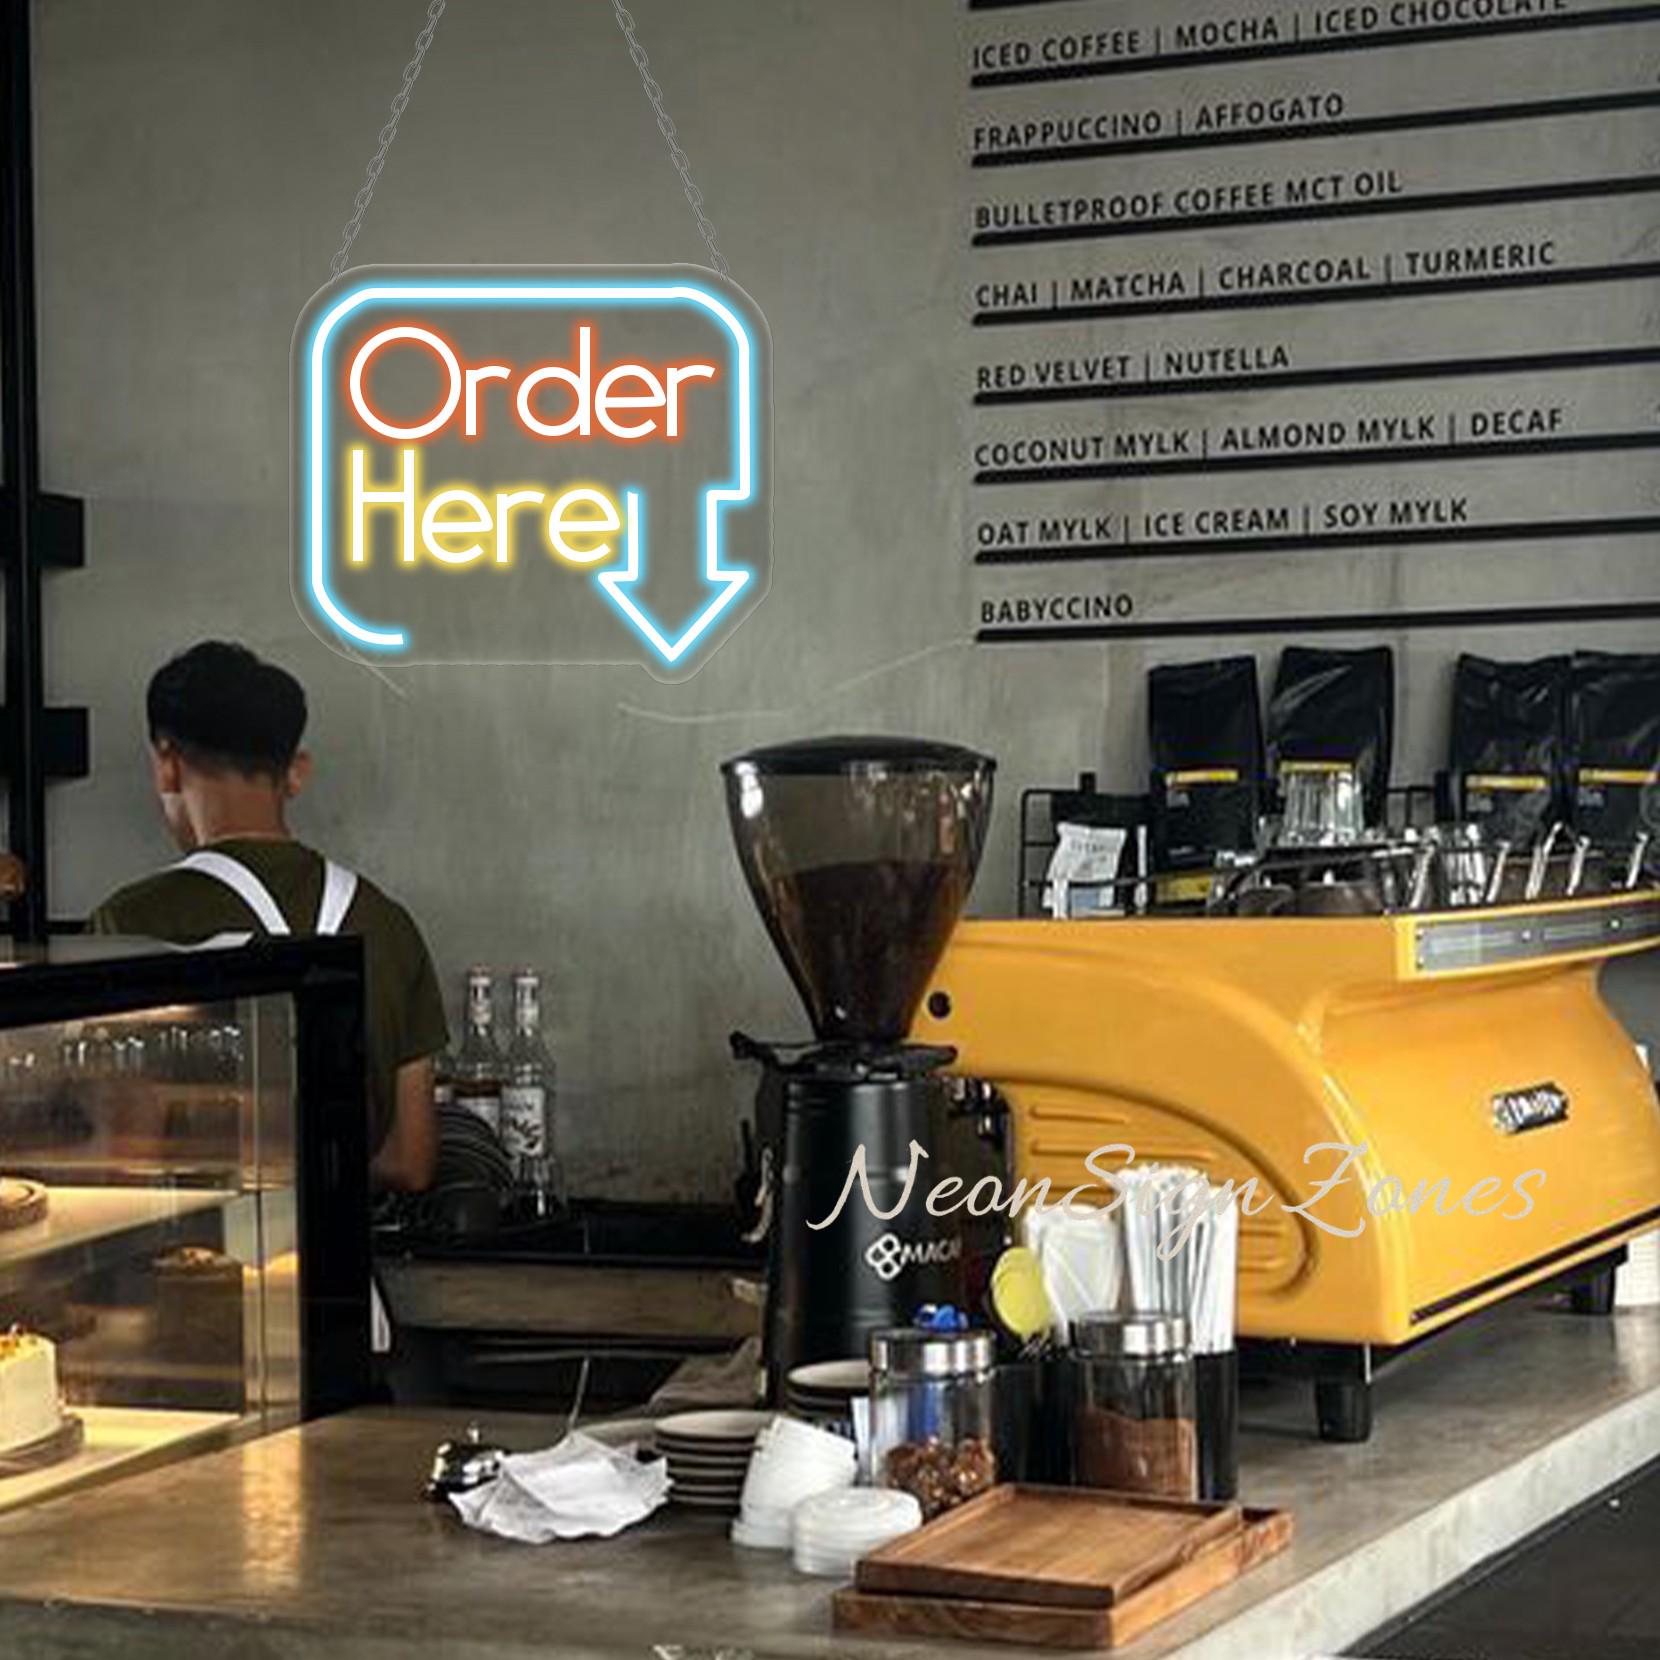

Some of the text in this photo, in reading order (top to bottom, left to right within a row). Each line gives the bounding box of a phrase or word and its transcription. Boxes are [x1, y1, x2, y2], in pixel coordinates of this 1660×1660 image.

[974, 42, 1030, 69] ICED
[1042, 30, 1139, 62] COFFEE
[1176, 17, 1279, 47] MOCHA
[1315, 6, 1378, 34] ICED
[974, 93, 1345, 151] FRAPPUCCINO AFFOGATO
[976, 169, 1403, 230] BULLETPROOF COFFEE MCT OIL
[976, 240, 1556, 310] CHAI MATCHA CHARCOAL TURMERIC
[349, 326, 716, 440] Order
[976, 345, 1289, 391] RED VELVET NUTELLA
[975, 408, 1563, 468] COCONUT MYLK ALMOND MYLK DECAF
[351, 449, 621, 565] Here
[977, 497, 1468, 547] OAT MYLK ICE CREAM SOY MYLK
[981, 592, 1133, 624] BABYCCINO
